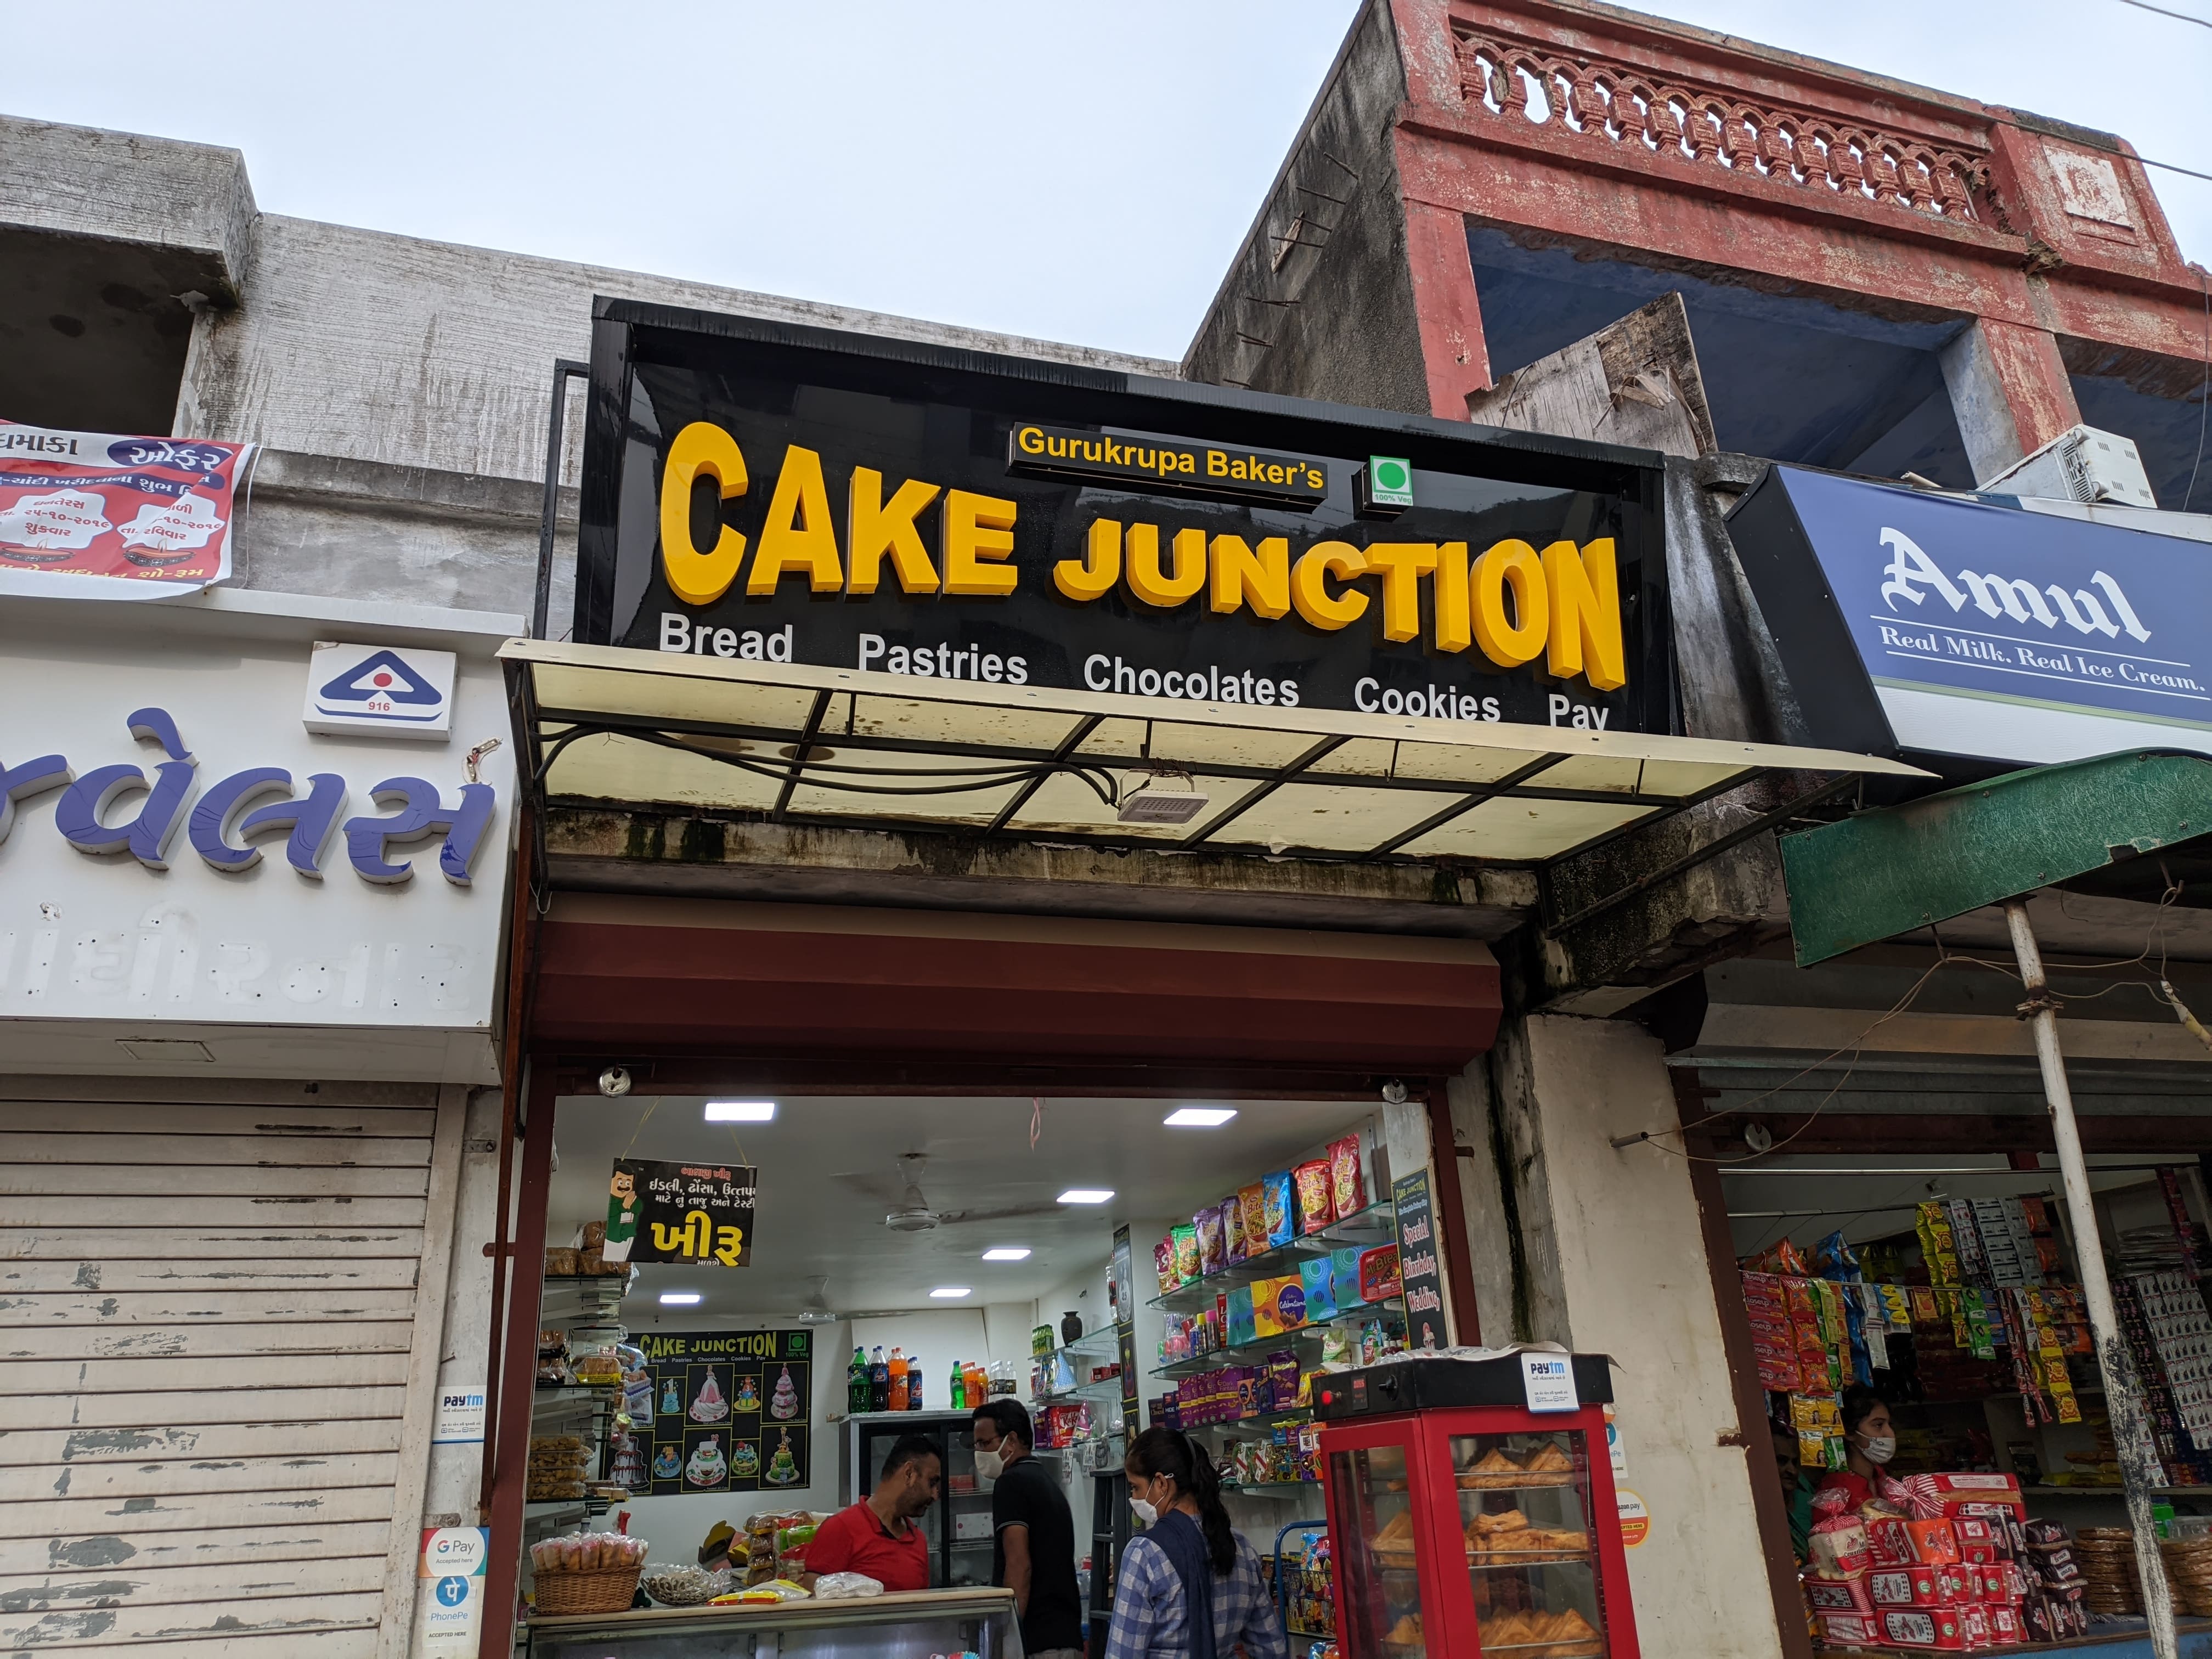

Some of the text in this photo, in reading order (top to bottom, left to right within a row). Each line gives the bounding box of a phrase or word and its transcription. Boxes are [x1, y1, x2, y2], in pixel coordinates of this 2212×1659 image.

[1019, 427, 1195, 476] Gurukrupa
[1397, 495, 1412, 505] Veg
[661, 421, 1626, 691] CAKE JUNCTION
[1880, 527, 2152, 644] Amul
[659, 612, 793, 663] Bread
[859, 633, 1028, 685] Pastries
[1085, 653, 1299, 707] Chocolates
[1355, 676, 1500, 723] Cookies
[1878, 625, 2206, 692] Real Milk. Real Ice Cream.
[368, 701, 391, 712] 916
[1396, 1188, 1406, 1201] CAKE
[1407, 1177, 1426, 1194] JUNCTION
[640, 1331, 777, 1358] CAKE JUNCTION
[453, 1540, 475, 1555] Pay
[431, 1611, 468, 1621] PhonePe
